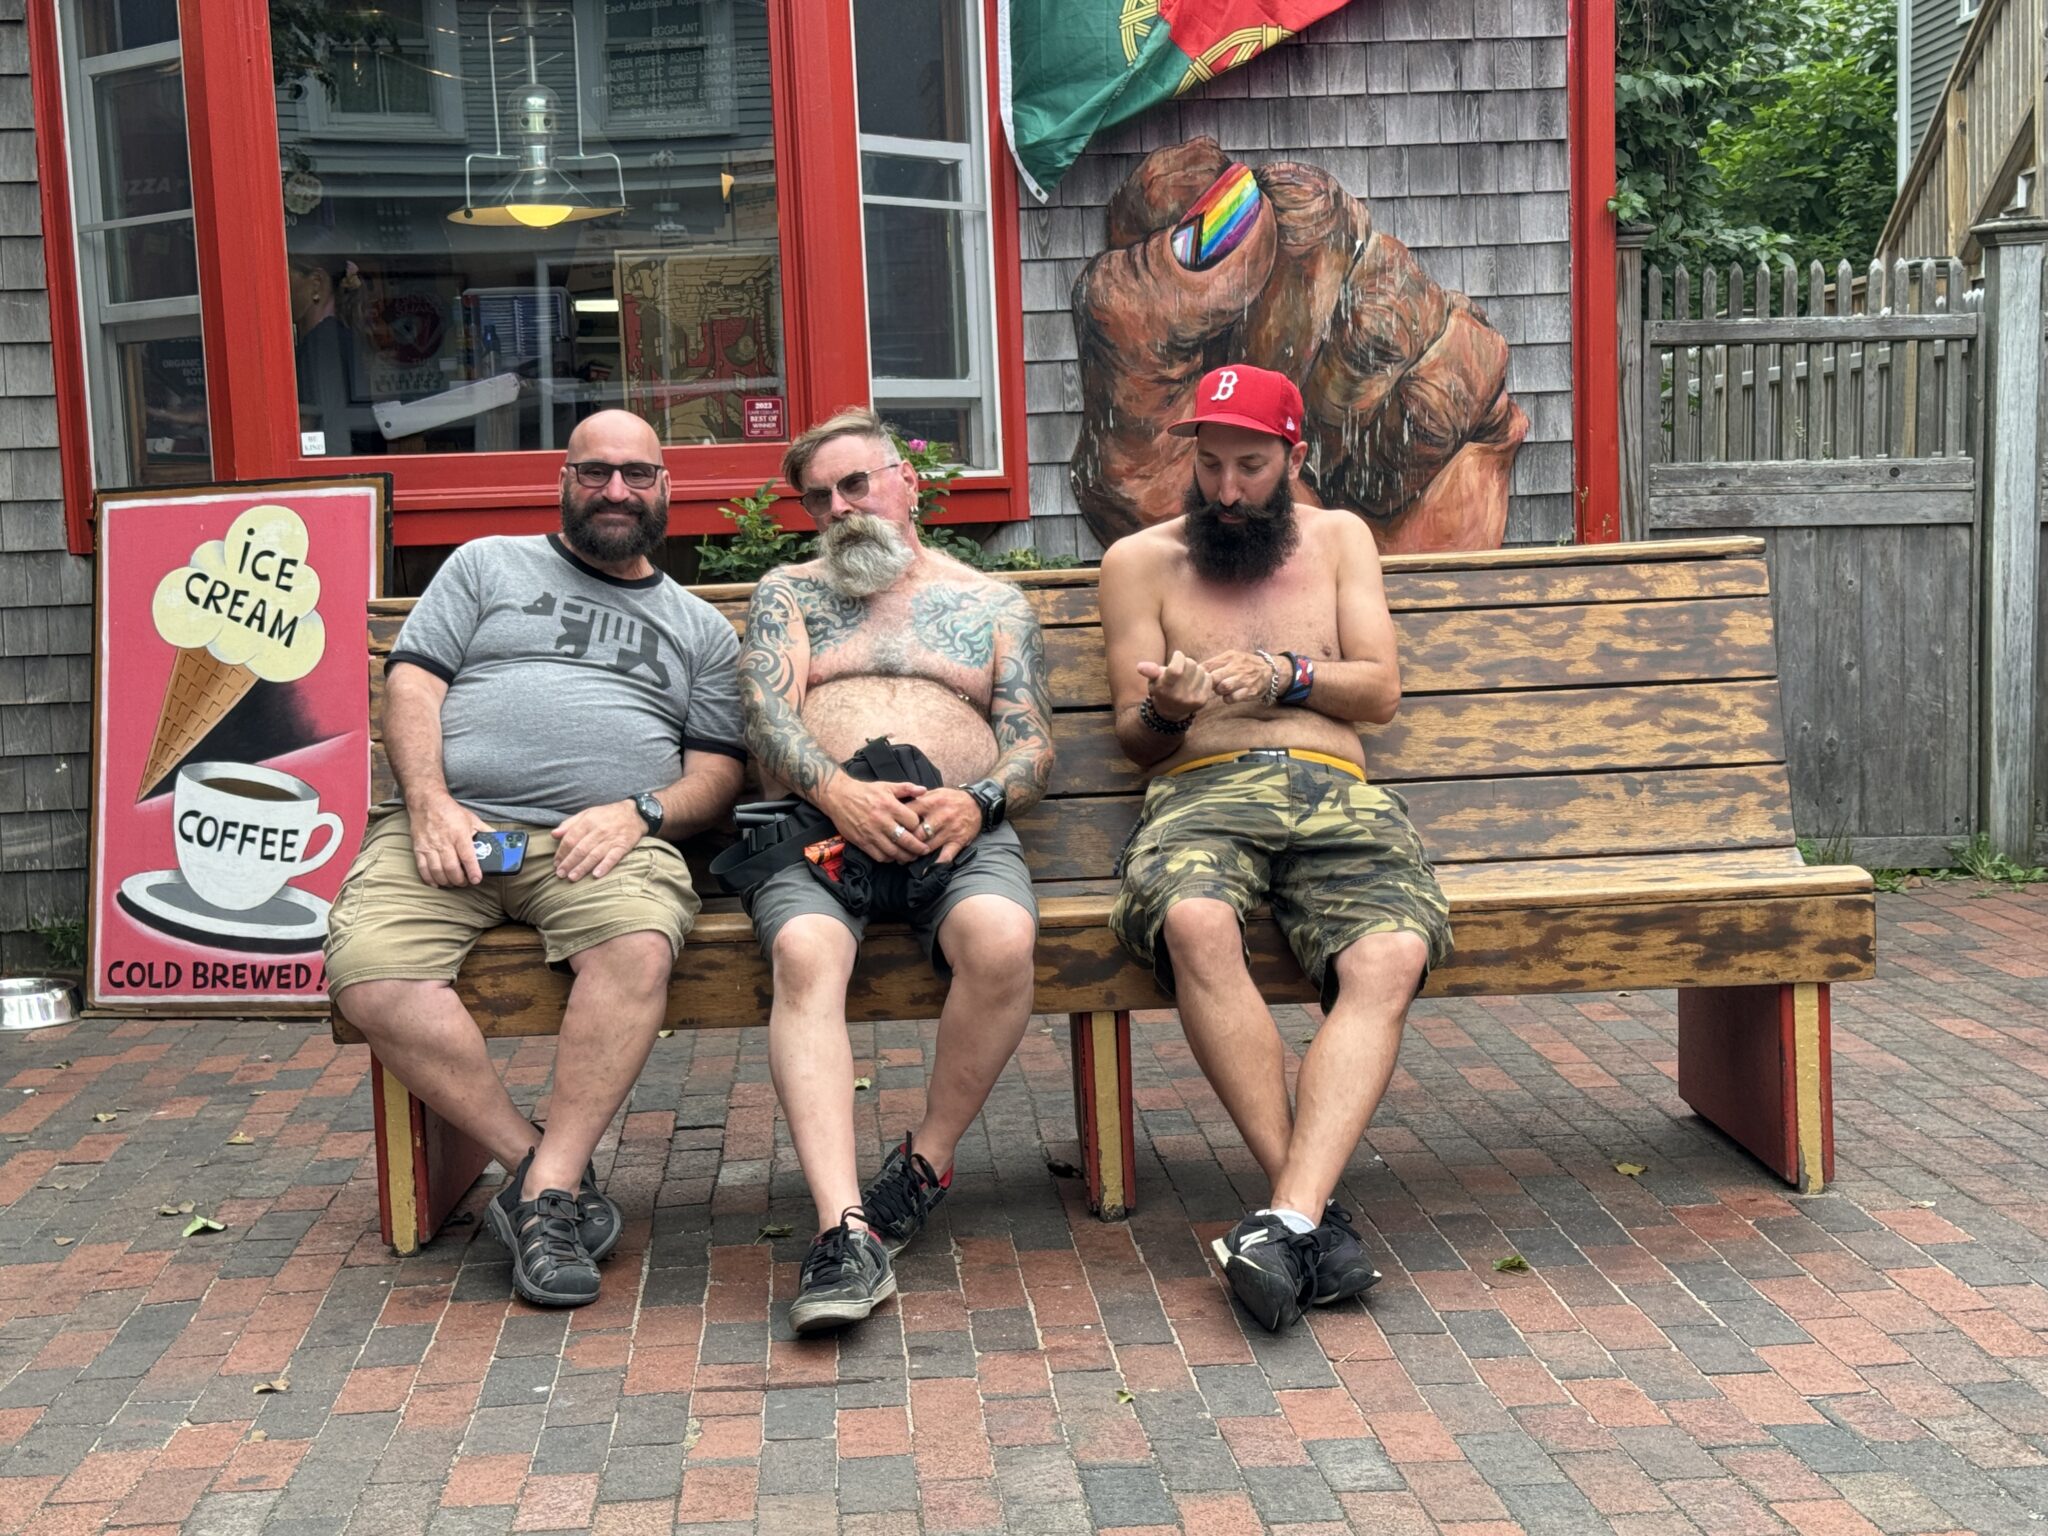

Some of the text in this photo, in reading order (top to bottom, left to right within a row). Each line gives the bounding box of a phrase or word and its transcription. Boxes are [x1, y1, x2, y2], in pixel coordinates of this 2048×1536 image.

[604, 4, 626, 15] Each
[652, 23, 699, 37] EGGPLANT
[610, 57, 633, 70] GREEN
[634, 54, 665, 67] PEPPERS
[670, 51, 702, 64] ROASTED
[639, 67, 664, 80] GARLIC
[668, 64, 698, 76] GRILLED
[700, 61, 730, 74] CHICKEN
[610, 83, 636, 96] CHEESE
[669, 77, 698, 90] CHEESE
[711, 98, 734, 111] PESTO
[1211, 370, 1239, 402] B
[185, 572, 300, 648] CREAM
[178, 809, 301, 864] COFFEE
[107, 960, 328, 992] COLD BREWED!
